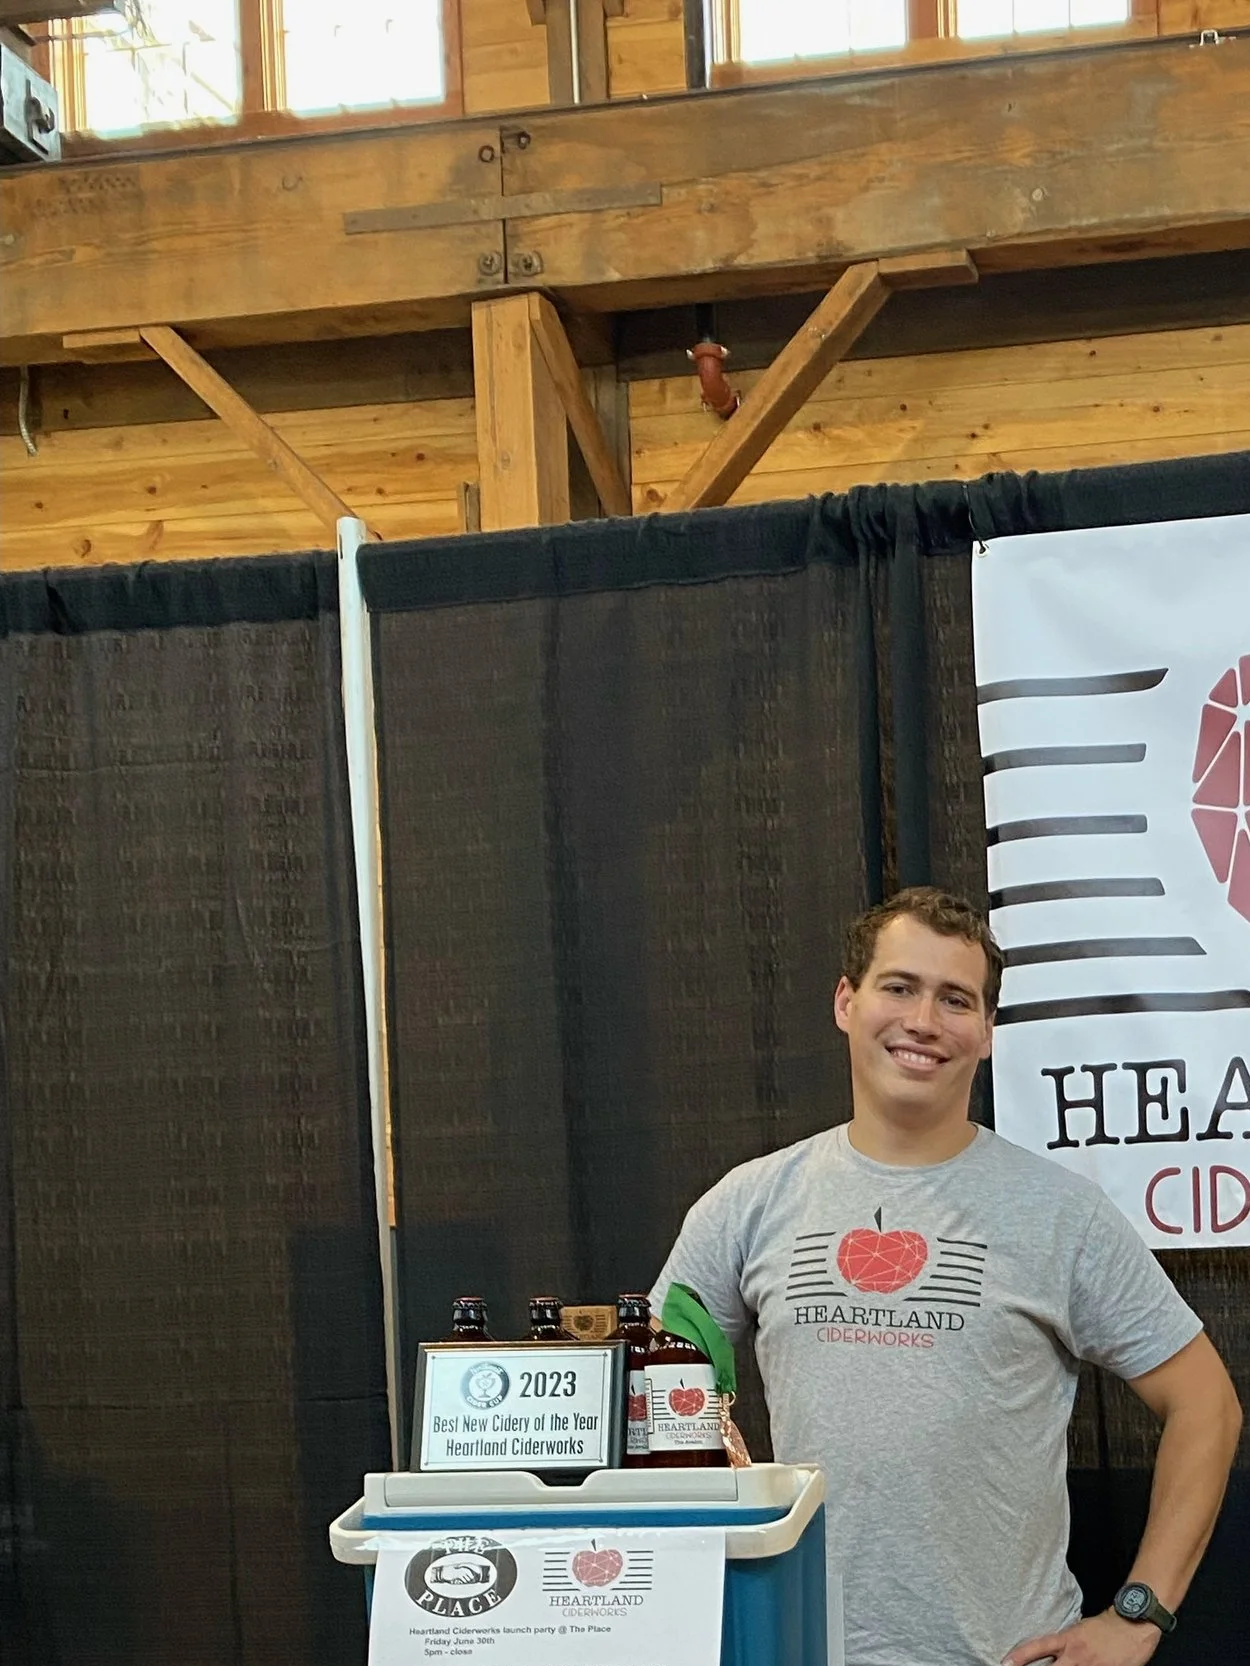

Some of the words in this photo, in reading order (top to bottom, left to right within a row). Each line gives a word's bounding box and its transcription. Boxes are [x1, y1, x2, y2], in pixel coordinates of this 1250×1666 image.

[794, 1305, 965, 1331] HEARTLAND
[817, 1327, 935, 1348] CIDERWORKS
[520, 1371, 577, 1398] 2023
[433, 1416, 458, 1433] Best
[462, 1415, 488, 1432] New
[492, 1414, 530, 1433] Cidery
[534, 1414, 546, 1431] of
[550, 1413, 569, 1430] the
[573, 1412, 598, 1430] Year
[658, 1422, 720, 1431] HEARTLAND
[446, 1439, 507, 1456] Heartland
[511, 1437, 584, 1455] Ciderworks
[416, 1588, 501, 1616] PLACE
[549, 1594, 644, 1607] HEARTLAND
[562, 1607, 627, 1617] CIDERWORKS
[409, 1627, 450, 1635] Heartland
[452, 1626, 501, 1635] Ciderworks
[502, 1626, 532, 1634] launch
[534, 1626, 556, 1636] party
[558, 1625, 567, 1635] @
[570, 1625, 586, 1633] The
[587, 1625, 611, 1633] Place
[425, 1637, 451, 1647] Friday
[453, 1637, 475, 1645] June
[477, 1637, 495, 1645] 30th
[424, 1648, 443, 1657] 5pm
[450, 1648, 472, 1656] close
